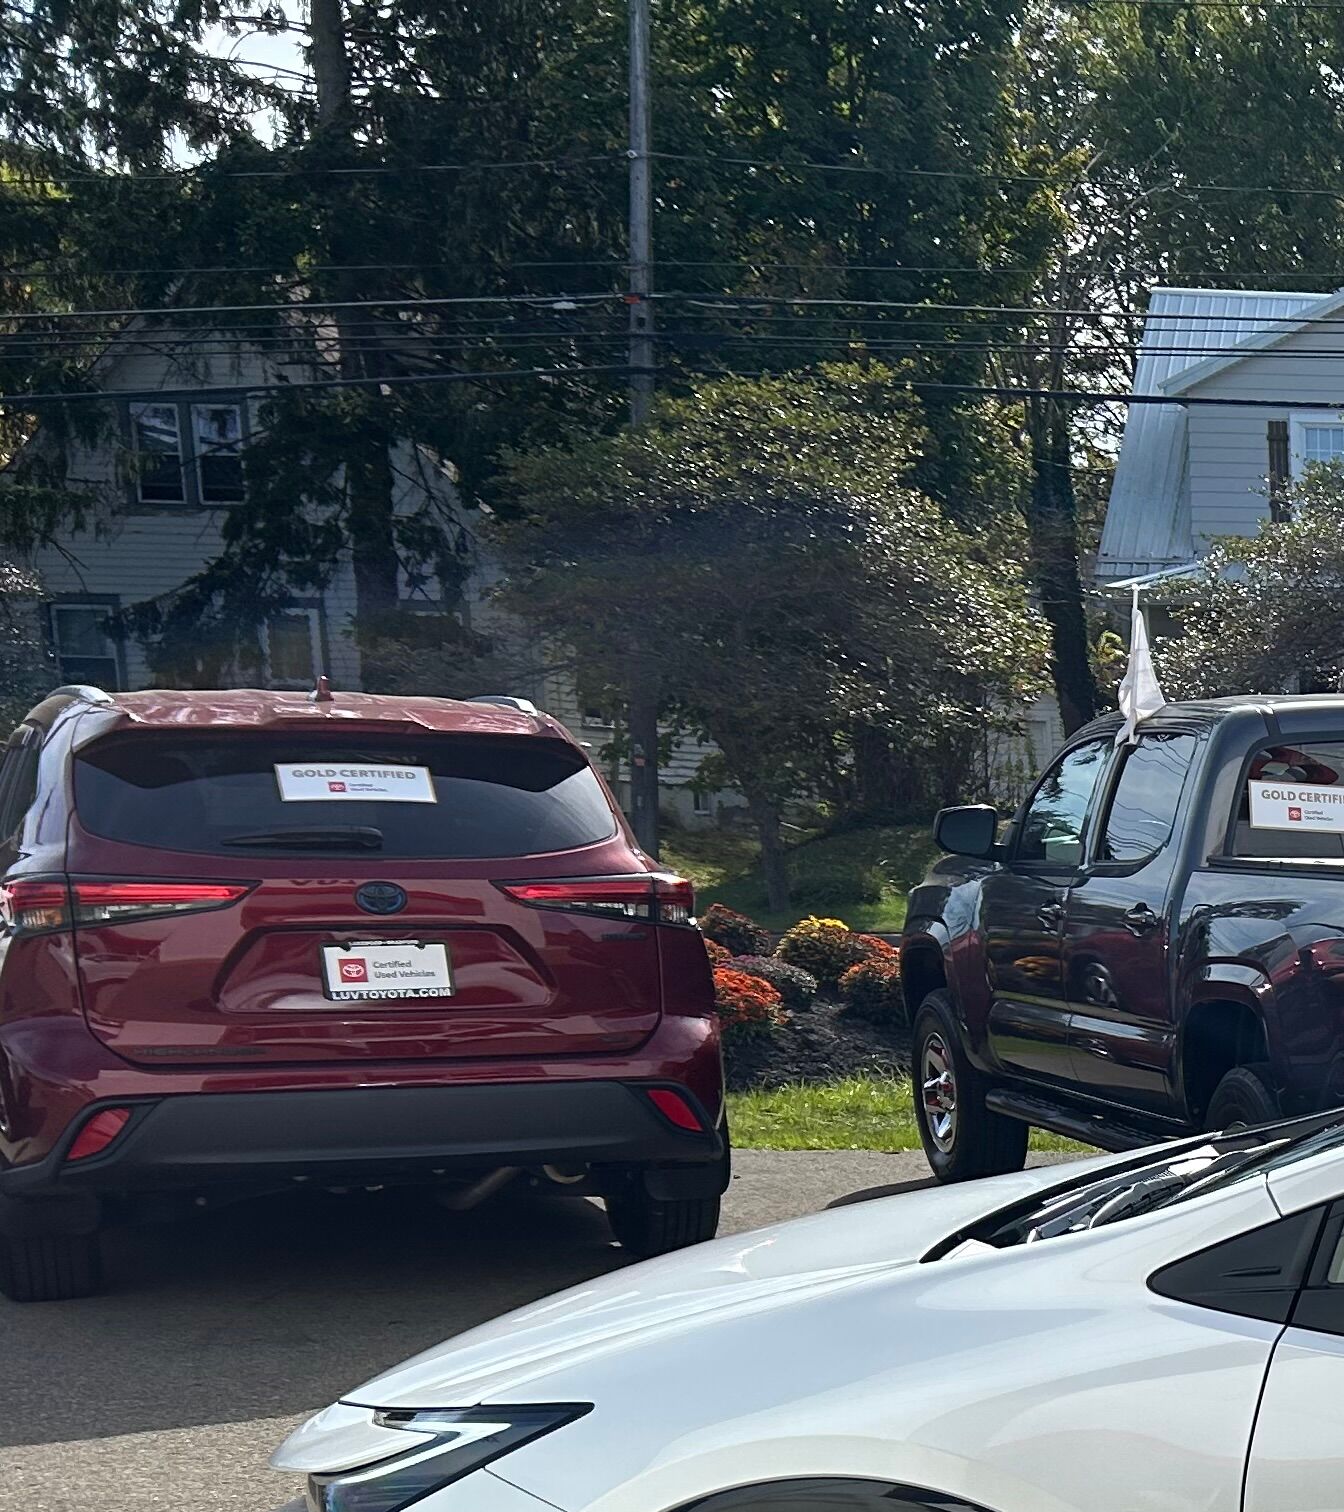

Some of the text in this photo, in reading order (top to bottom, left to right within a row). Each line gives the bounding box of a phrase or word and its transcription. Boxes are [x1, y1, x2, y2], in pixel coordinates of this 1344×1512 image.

[292, 769, 417, 780] GOLD CERTIFIED
[1261, 789, 1297, 802] GOLD
[372, 960, 412, 969] Certified
[374, 970, 436, 979] Used Vehicles
[331, 987, 452, 1000] LUVTOYOTA.COM
